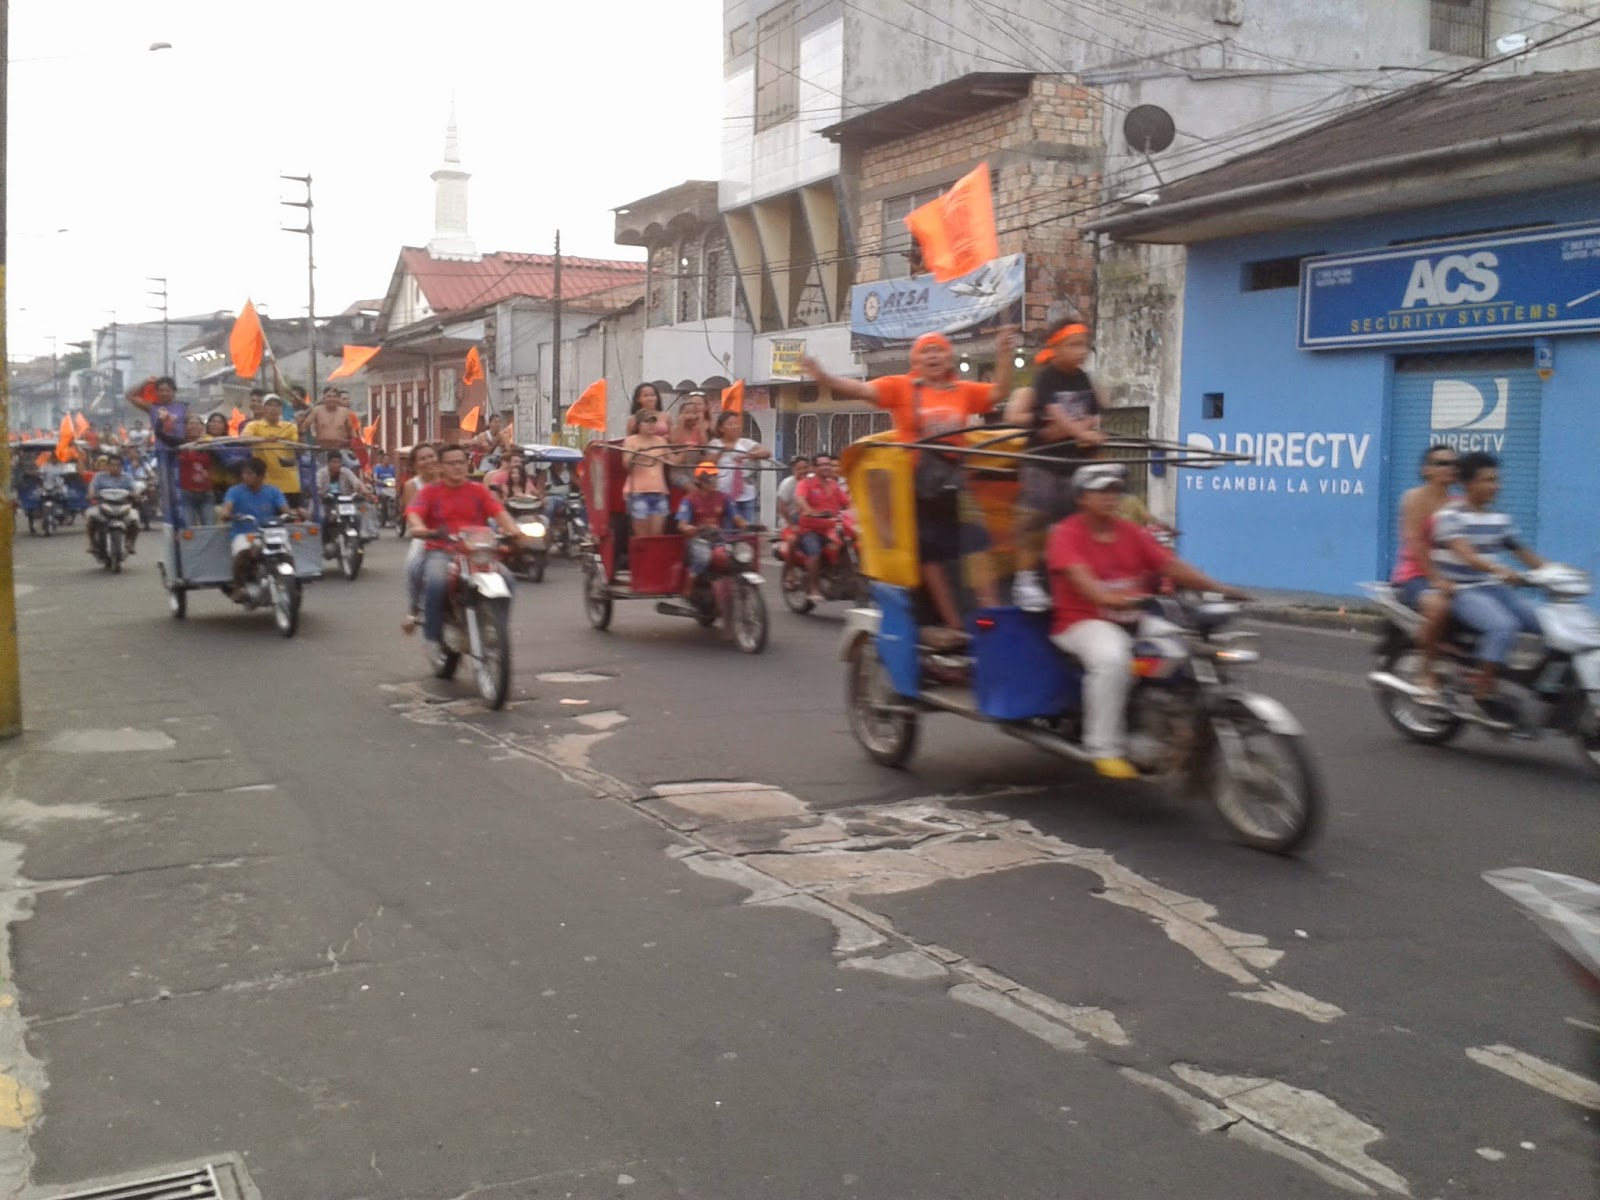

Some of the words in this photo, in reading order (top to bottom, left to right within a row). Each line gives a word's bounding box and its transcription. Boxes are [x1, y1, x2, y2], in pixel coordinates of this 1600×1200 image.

[1401, 251, 1500, 309] ACS
[1350, 313, 1446, 333] SECURITY
[1458, 303, 1558, 325] SYSTEMS
[1234, 432, 1370, 469] DIRECTV
[1429, 433, 1505, 453] DIRECTV
[1185, 476, 1204, 490] TE
[1212, 476, 1277, 492] CAMBIA
[1287, 478, 1309, 493] LA
[1319, 479, 1365, 495] VIDA
